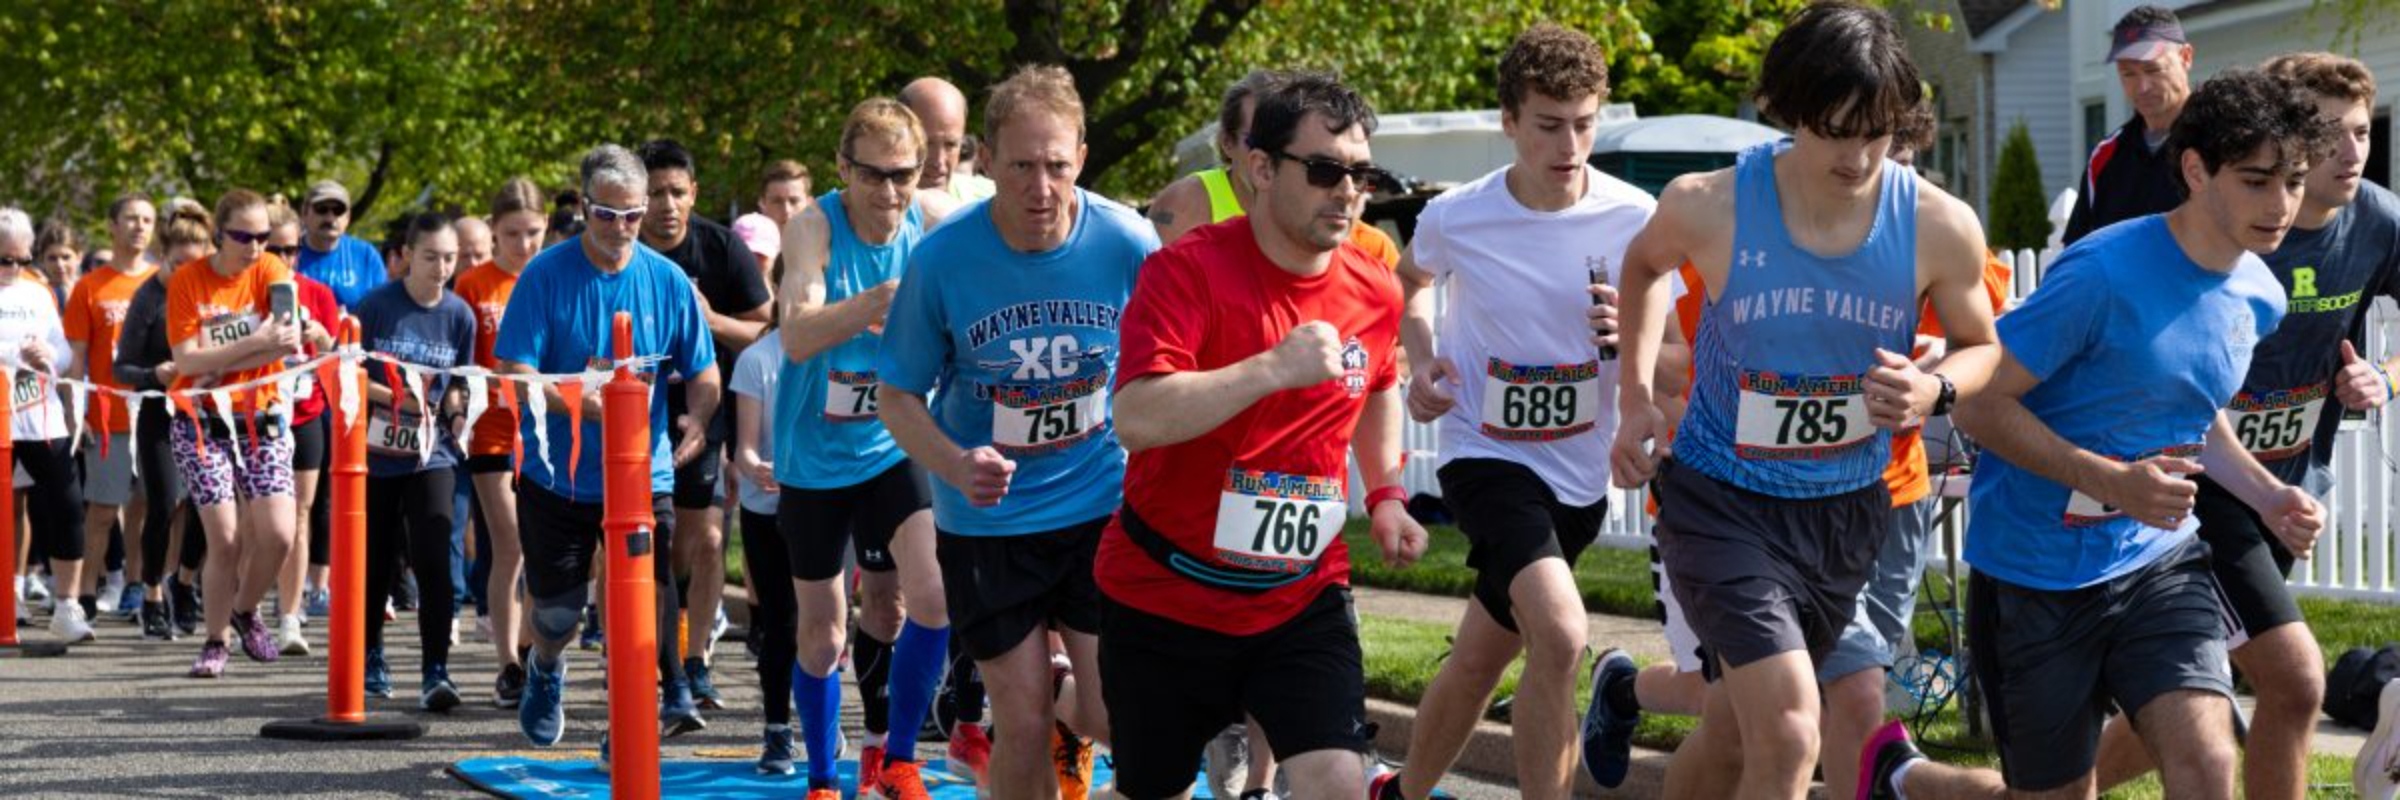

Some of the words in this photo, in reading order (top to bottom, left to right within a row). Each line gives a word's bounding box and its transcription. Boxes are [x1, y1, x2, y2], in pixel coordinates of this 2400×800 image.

[2291, 267, 2317, 298] R
[967, 301, 1041, 350] WAYNE
[1044, 299, 1121, 332] VALLEY
[1733, 287, 1815, 324] WAYNE
[1825, 289, 1905, 330] VALLEY
[1010, 334, 1079, 380] XC
[1528, 361, 1595, 382] AMERICA
[1748, 371, 1787, 393] RUN
[1796, 374, 1864, 393] AMERIC
[1024, 402, 1080, 444] 751
[1503, 385, 1577, 428] 689
[1775, 399, 1848, 445] 785
[2237, 407, 2305, 451] 655
[1232, 469, 1267, 492] RUN
[1276, 476, 1343, 500] AMERICA
[1251, 500, 1320, 557] 766
